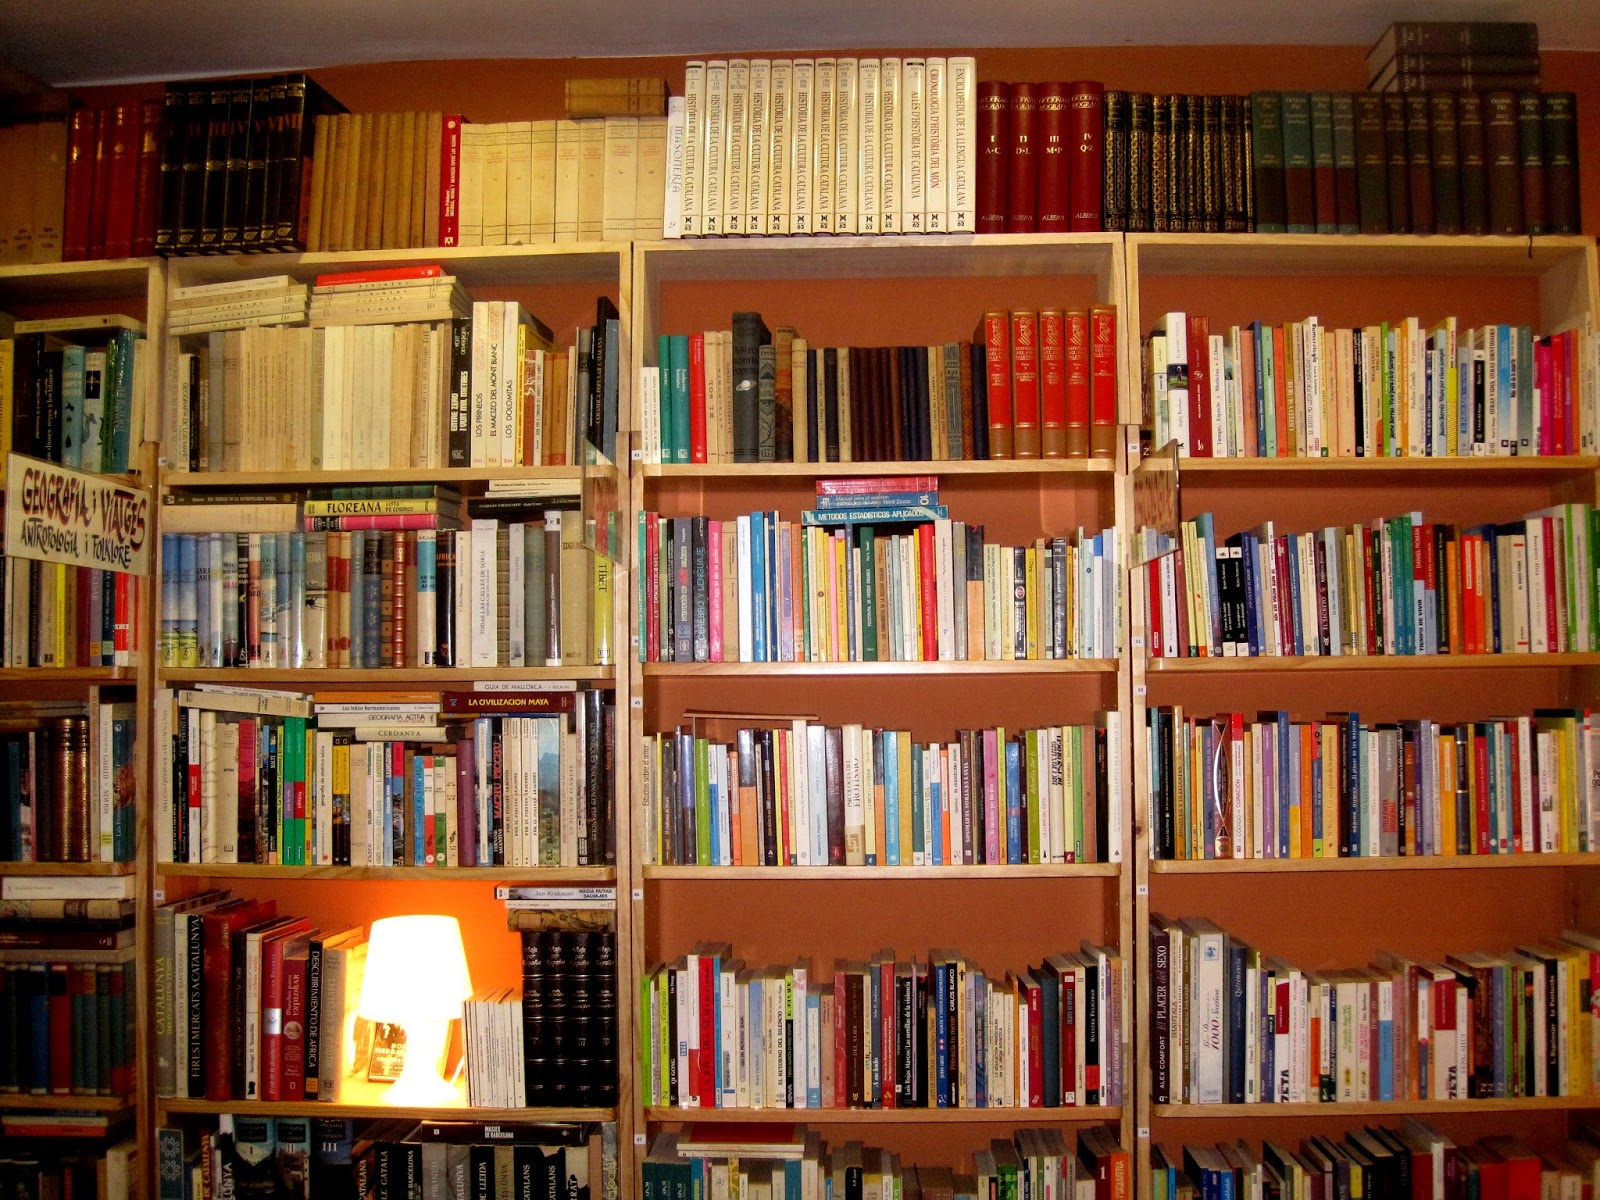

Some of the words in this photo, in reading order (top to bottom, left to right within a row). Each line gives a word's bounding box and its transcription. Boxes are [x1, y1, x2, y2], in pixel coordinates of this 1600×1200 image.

[930, 69, 939, 116] CRONOLOGIA
[753, 125, 762, 134] DE
[884, 124, 893, 132] DE
[956, 119, 965, 129] DE
[956, 130, 965, 138] LA
[752, 134, 761, 144] LA
[884, 133, 893, 142] LA
[751, 144, 761, 174] CULTURA
[884, 142, 893, 172] CULTURA
[911, 150, 920, 160] DE
[930, 157, 939, 170] DEL
[956, 139, 966, 170] LLENGUA
[750, 175, 760, 210] CATALANA
[884, 174, 893, 208] CATALANA
[911, 160, 920, 199] CATALUNYA
[956, 170, 966, 206] CATALANA
[326, 502, 382, 514] FLOREANA
[920, 494, 929, 505] 10
[849, 511, 890, 520] ESTADISTICOS
[1418, 618, 1423, 626] DE
[493, 742, 502, 780] PICCHU
[494, 782, 502, 819] MACHU
[191, 919, 200, 982] CATALUNYA
[1157, 945, 1166, 968] SEXO
[310, 951, 320, 1025] DESCUBRIMIENTO
[1157, 970, 1166, 984] del
[155, 956, 165, 1034] CATALUNYA
[1157, 986, 1166, 1019] PLACER
[191, 991, 200, 1040] MERCATS
[310, 1026, 317, 1037] DE
[1211, 1020, 1219, 1050] 1000
[191, 1046, 200, 1077] FIRES
[309, 1039, 317, 1068] AFRICA
[904, 1070, 912, 1084] Rojas
[322, 1141, 337, 1152] III
[1100, 1167, 1106, 1179] 1
